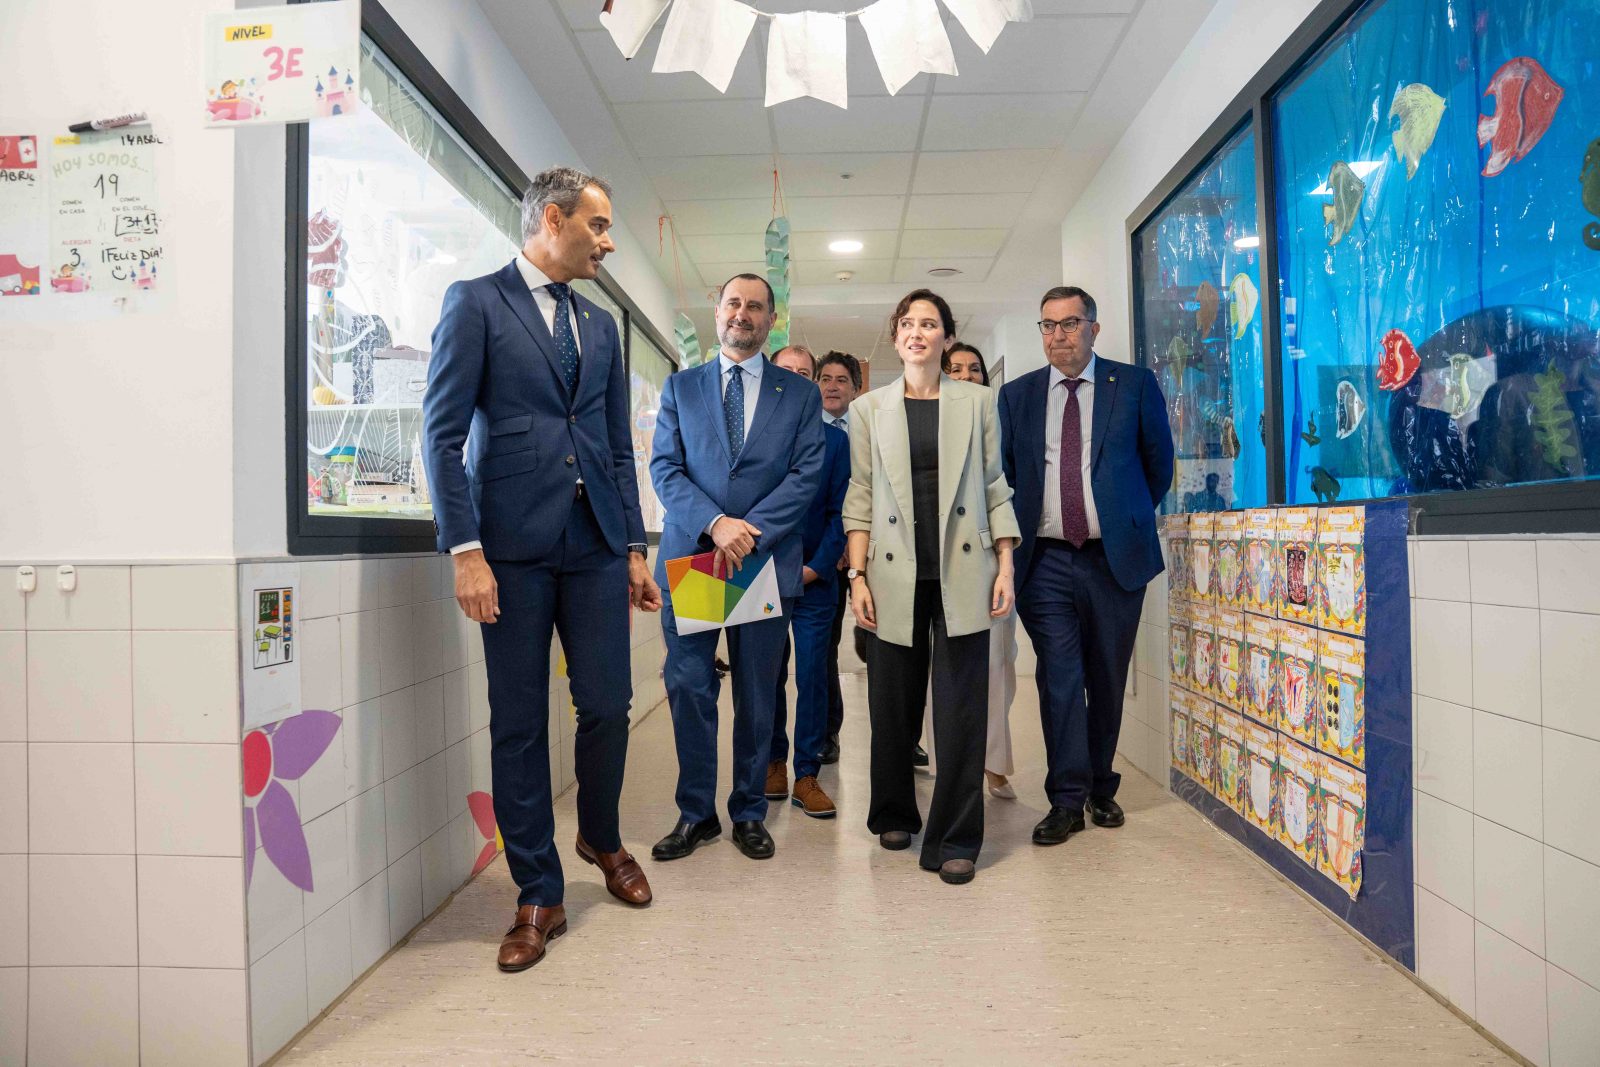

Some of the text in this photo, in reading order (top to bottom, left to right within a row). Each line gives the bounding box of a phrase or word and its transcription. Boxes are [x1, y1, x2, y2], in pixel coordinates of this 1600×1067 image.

[232, 26, 266, 40] NIVEL
[263, 46, 303, 81] 3E
[121, 134, 135, 146] 14
[52, 156, 81, 178] HOY
[94, 173, 119, 199] 19
[70, 247, 81, 267] 3
